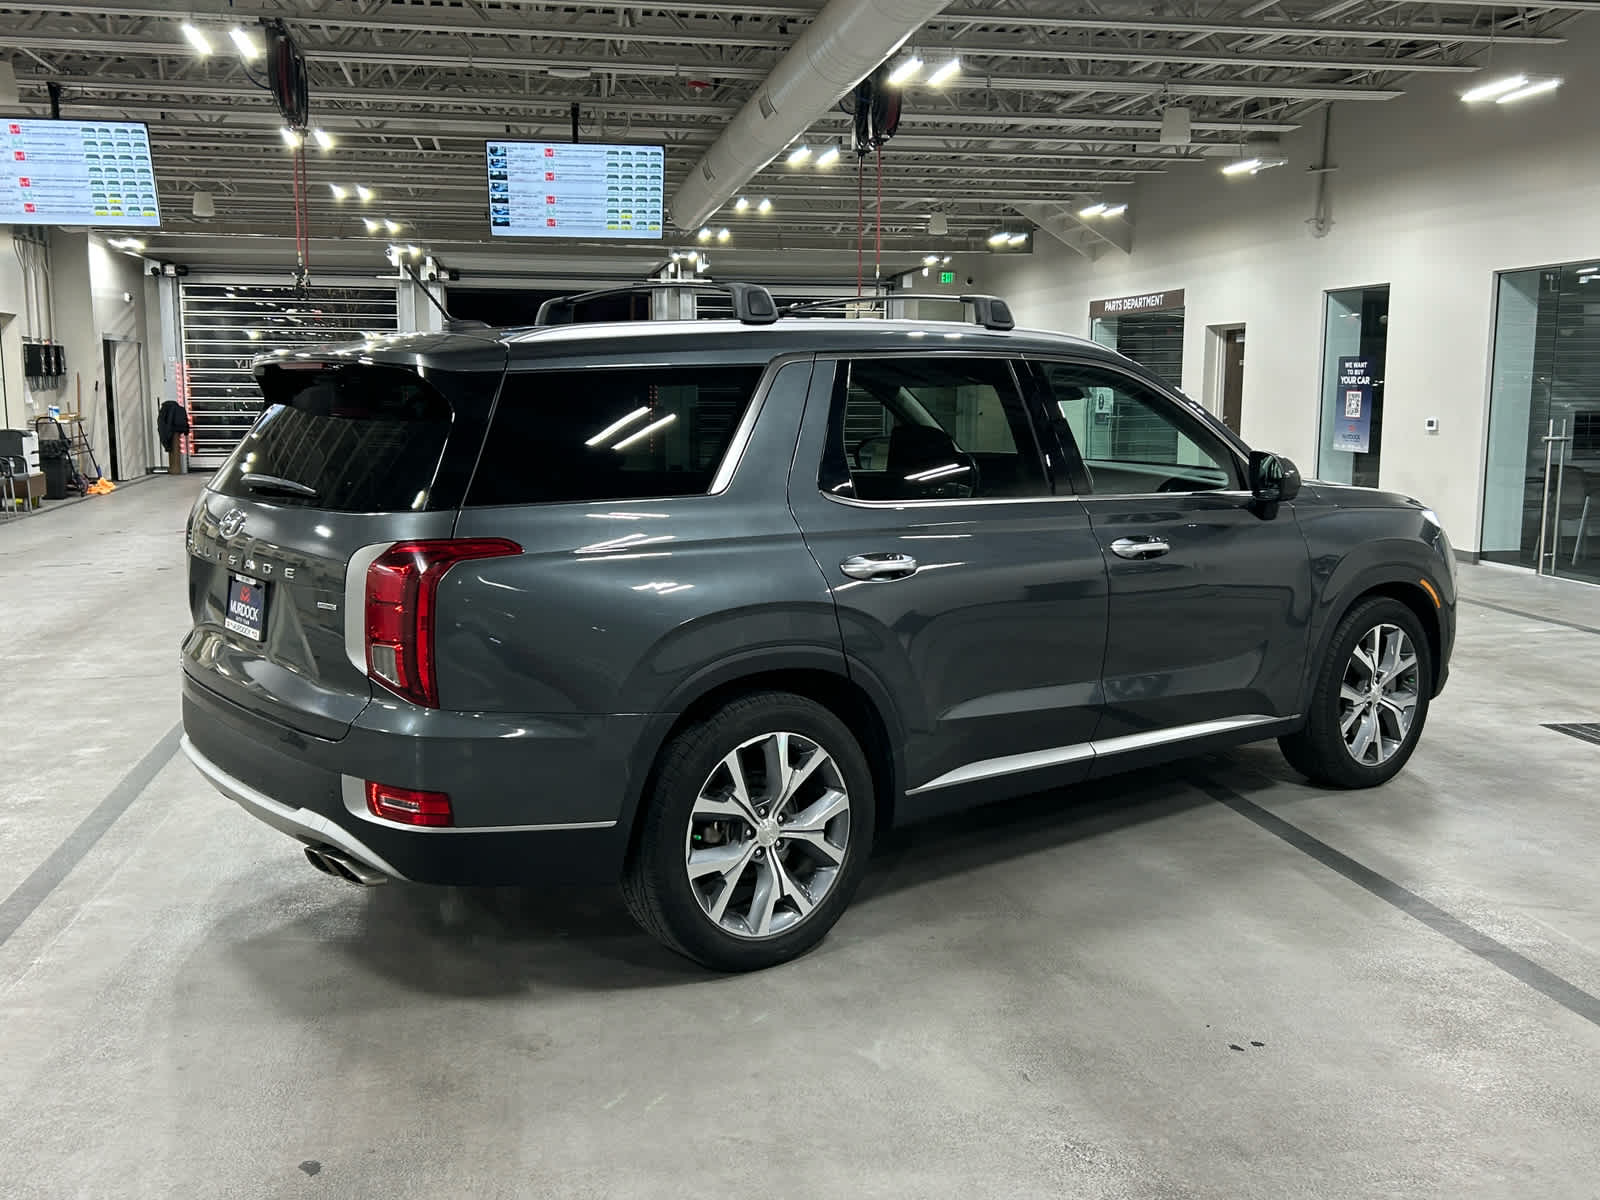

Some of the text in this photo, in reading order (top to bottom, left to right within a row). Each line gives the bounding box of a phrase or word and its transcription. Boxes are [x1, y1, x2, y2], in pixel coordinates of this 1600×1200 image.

[1104, 295, 1164, 311] PARTS DEPARTMENT
[1340, 376, 1370, 384] YOUR CAR
[230, 599, 259, 622] MURDOCK
